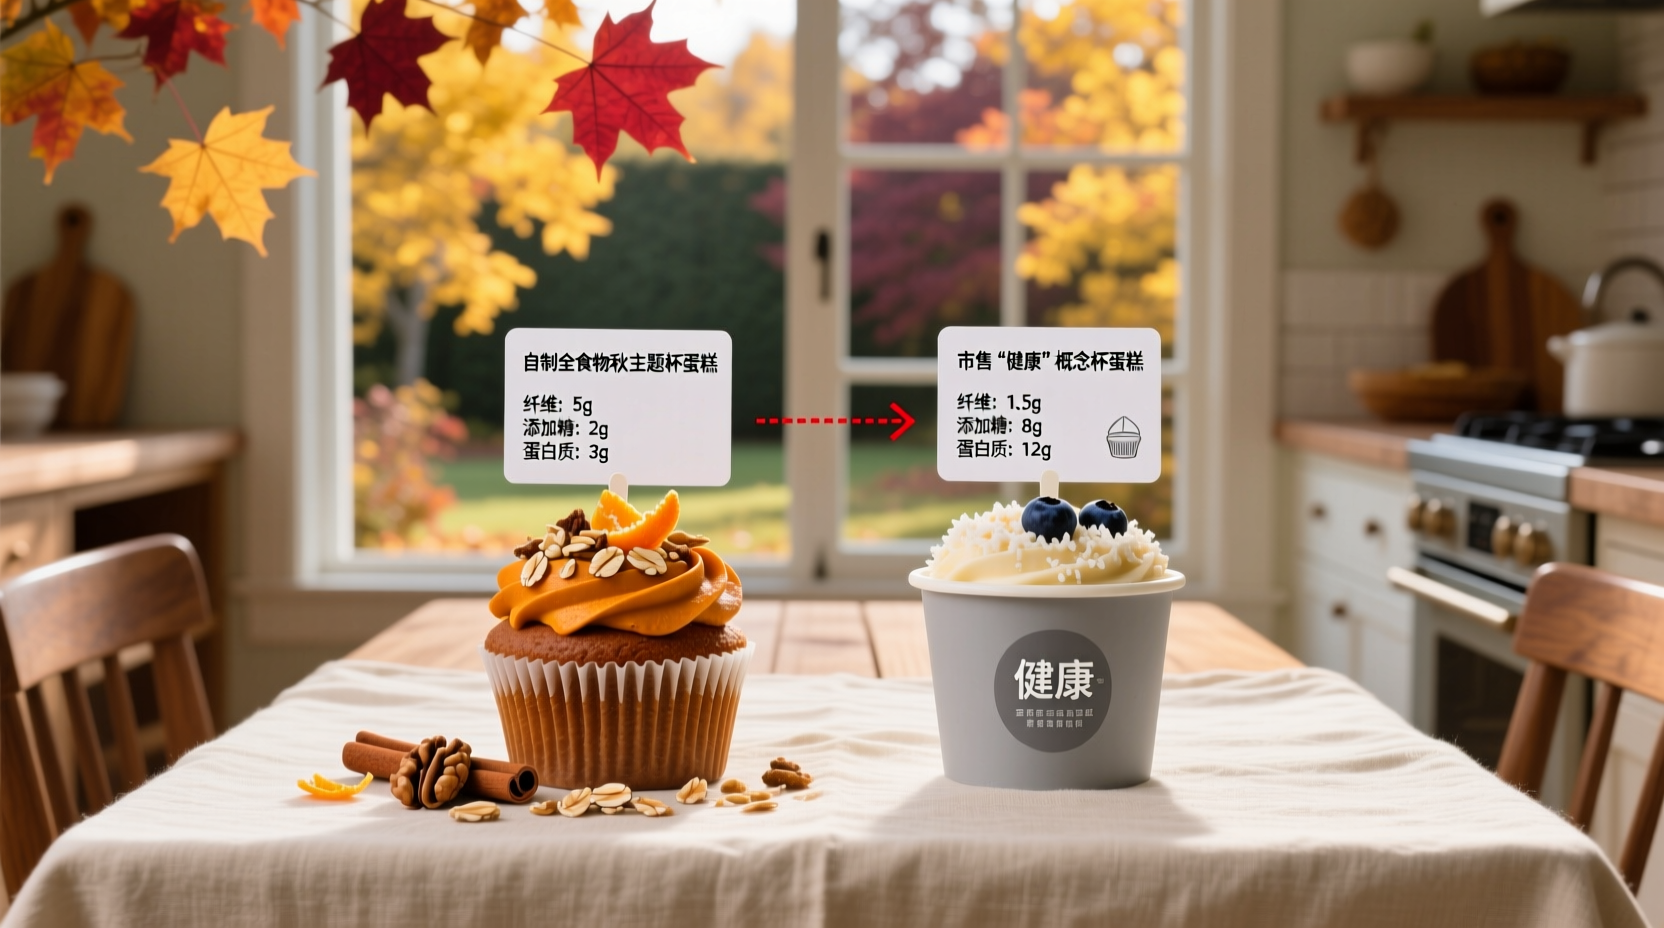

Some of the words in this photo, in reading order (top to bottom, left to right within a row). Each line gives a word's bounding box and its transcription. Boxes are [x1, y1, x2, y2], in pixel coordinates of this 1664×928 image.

[524, 351, 719, 374] 自制全食物秋主题杯蛋糕
[1014, 658, 1095, 700] 健康
